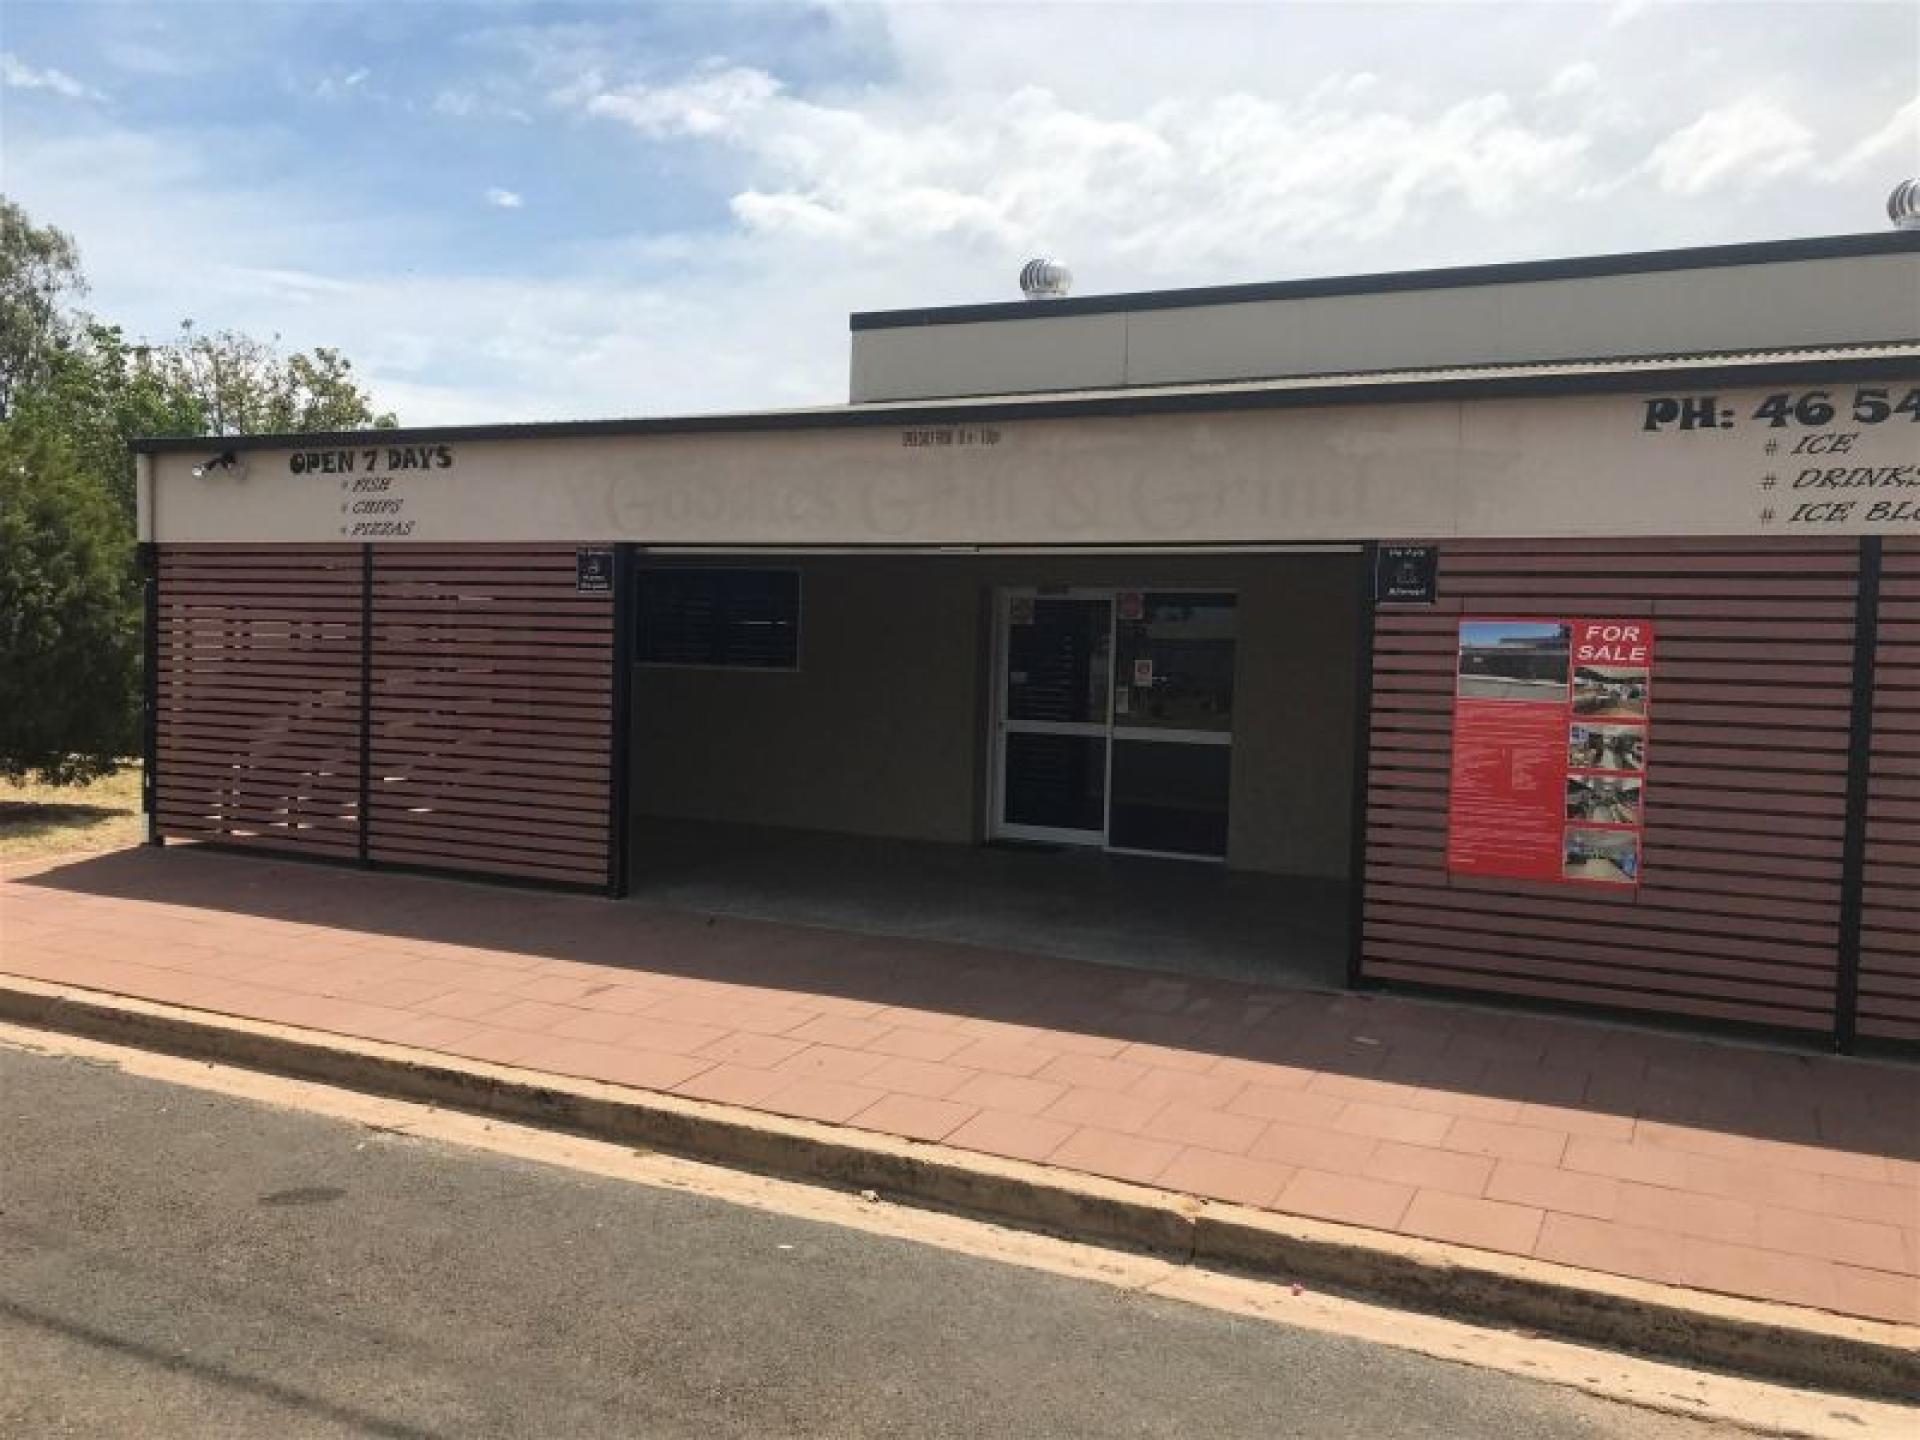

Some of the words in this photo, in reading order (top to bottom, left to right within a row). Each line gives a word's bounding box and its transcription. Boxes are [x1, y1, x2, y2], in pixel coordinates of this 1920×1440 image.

[1642, 395, 1735, 431] PH:
[1752, 391, 1835, 427] 46
[1790, 432, 1859, 454] ICE
[289, 450, 354, 474] OPEN
[363, 450, 377, 471] 7
[388, 446, 453, 470] DAYS
[1788, 501, 1857, 523] ICE
[1865, 501, 1920, 522] BL
[1586, 625, 1640, 641] FOR
[1577, 645, 1647, 661] SALE
